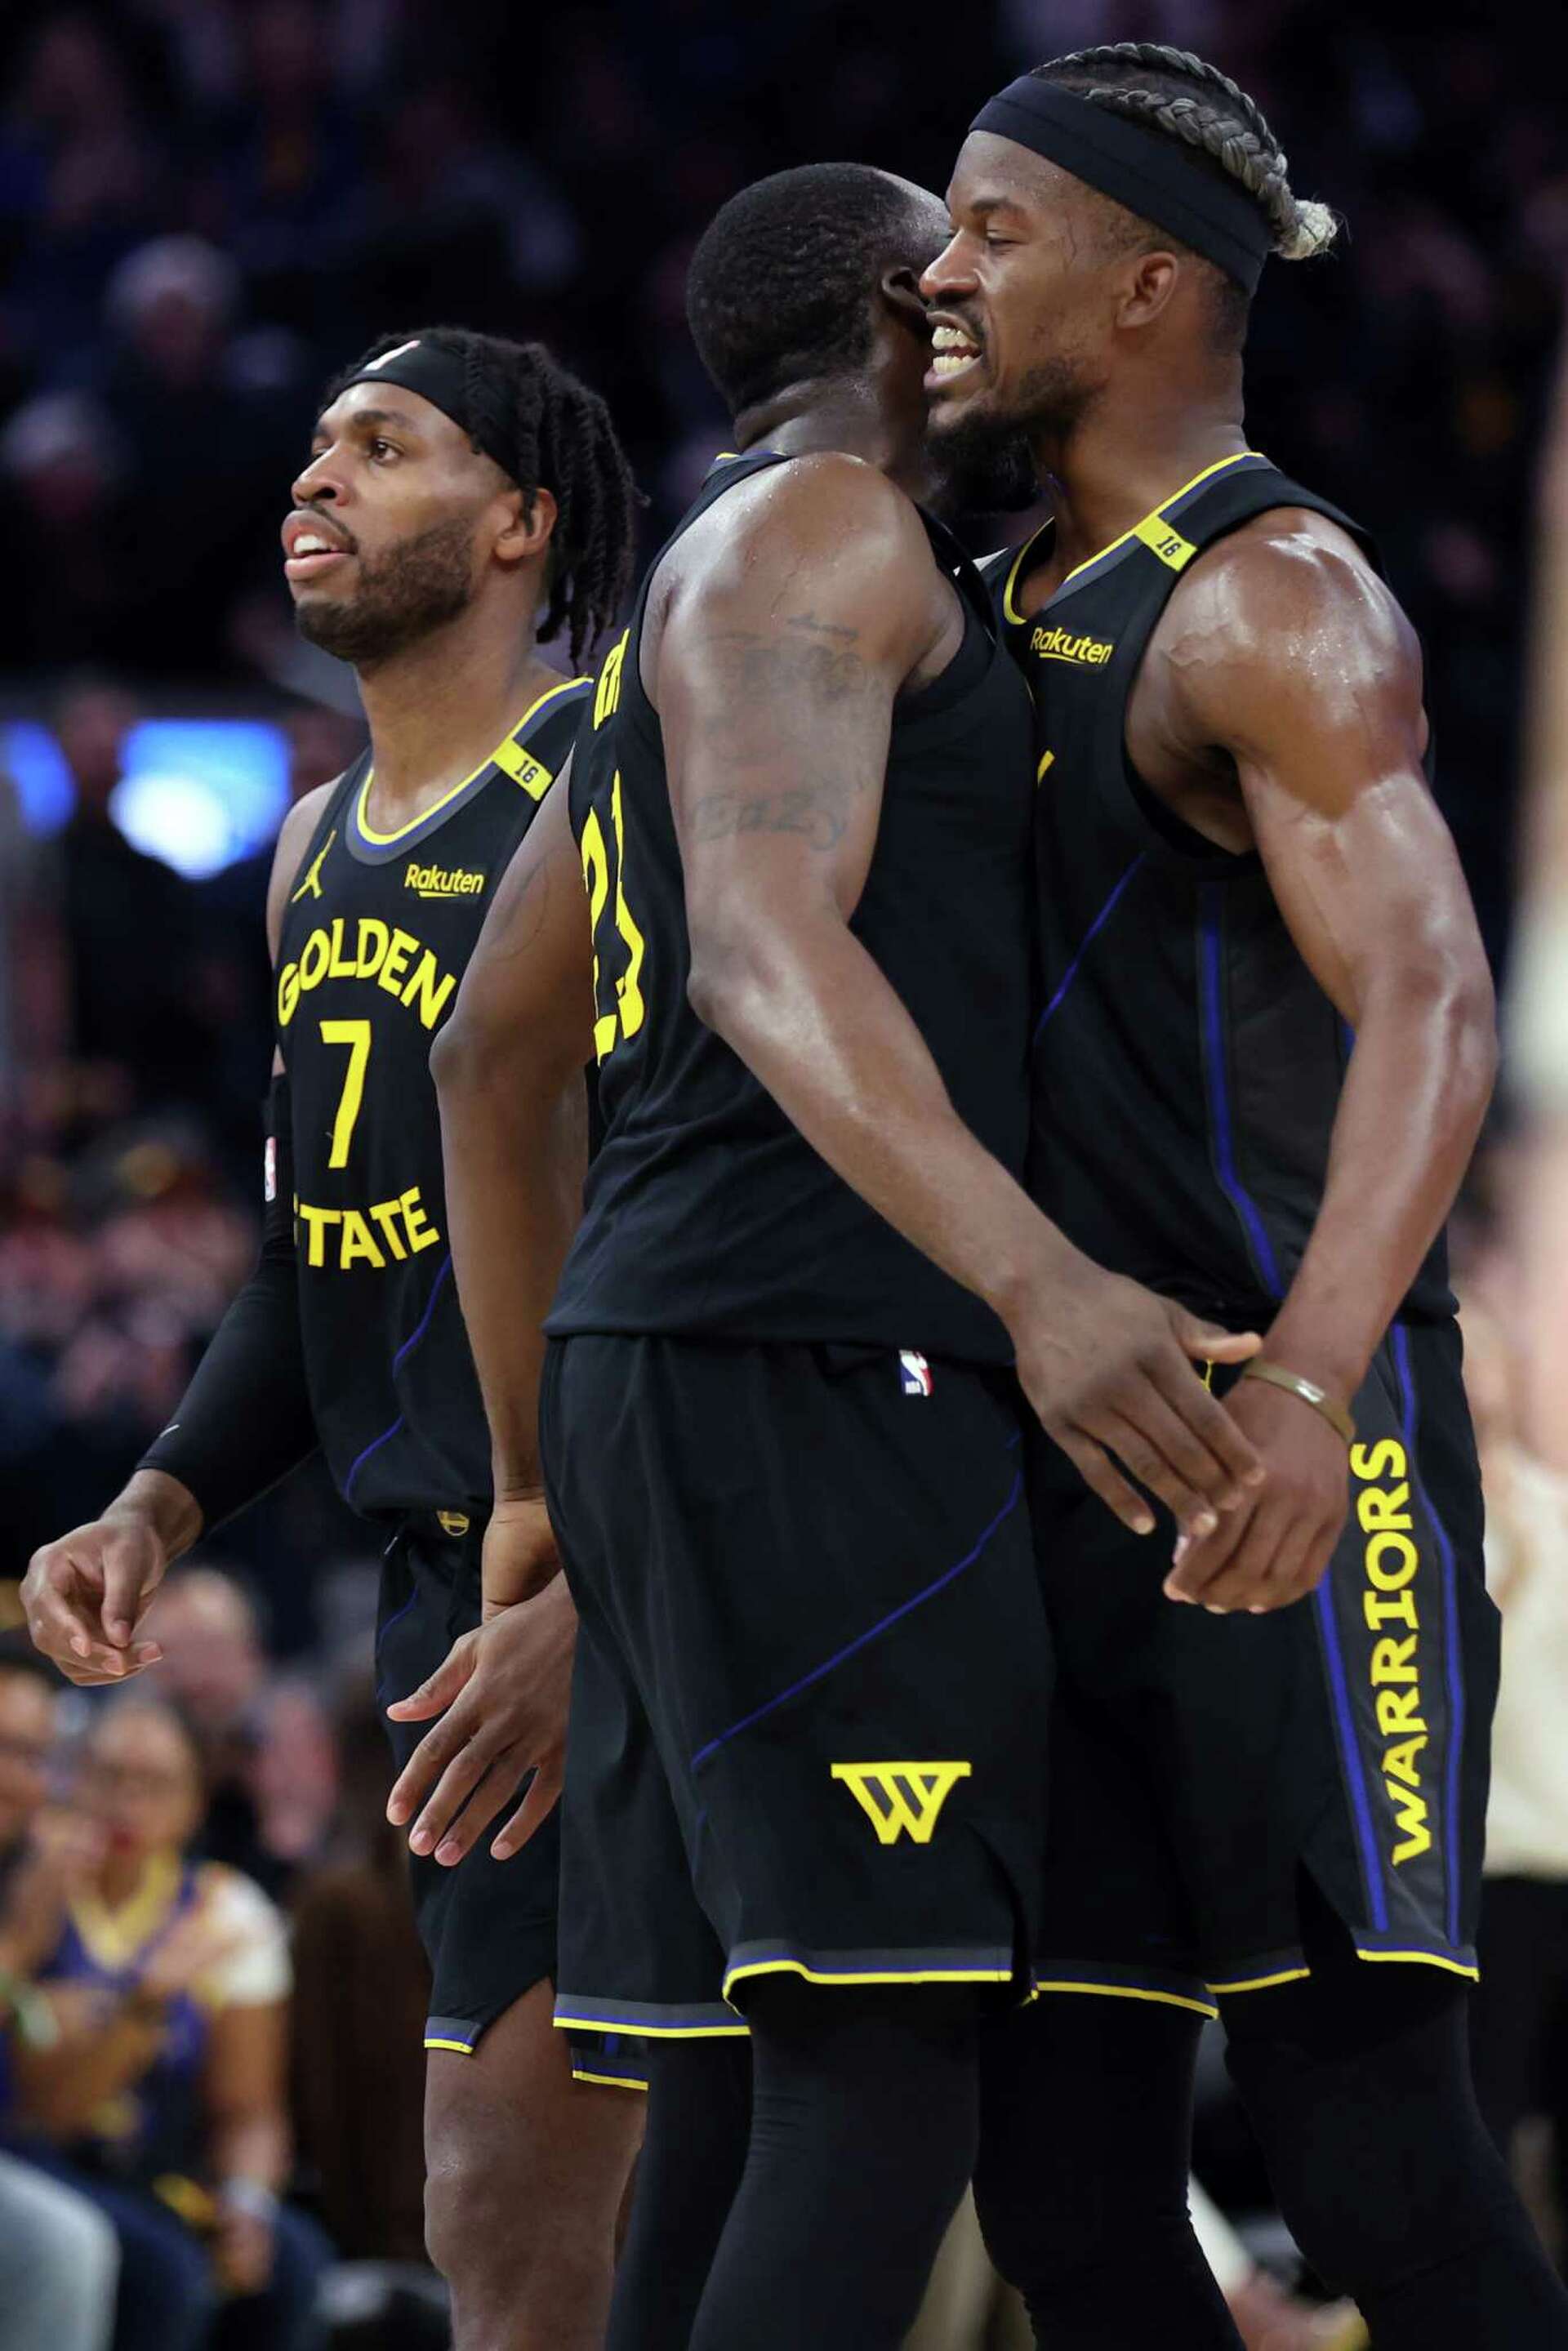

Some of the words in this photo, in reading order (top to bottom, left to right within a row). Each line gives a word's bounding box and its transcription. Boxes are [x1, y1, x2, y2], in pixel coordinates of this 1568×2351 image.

[1156, 535, 1182, 557] 16
[1030, 626, 1113, 665] Rakuten
[514, 759, 539, 783] 16
[404, 863, 484, 895] Rakuten
[278, 917, 456, 1030] GOLDEN
[319, 1019, 372, 1169] 7
[293, 1187, 439, 1270] TATE
[1349, 1438, 1432, 1865] WARRIORS
